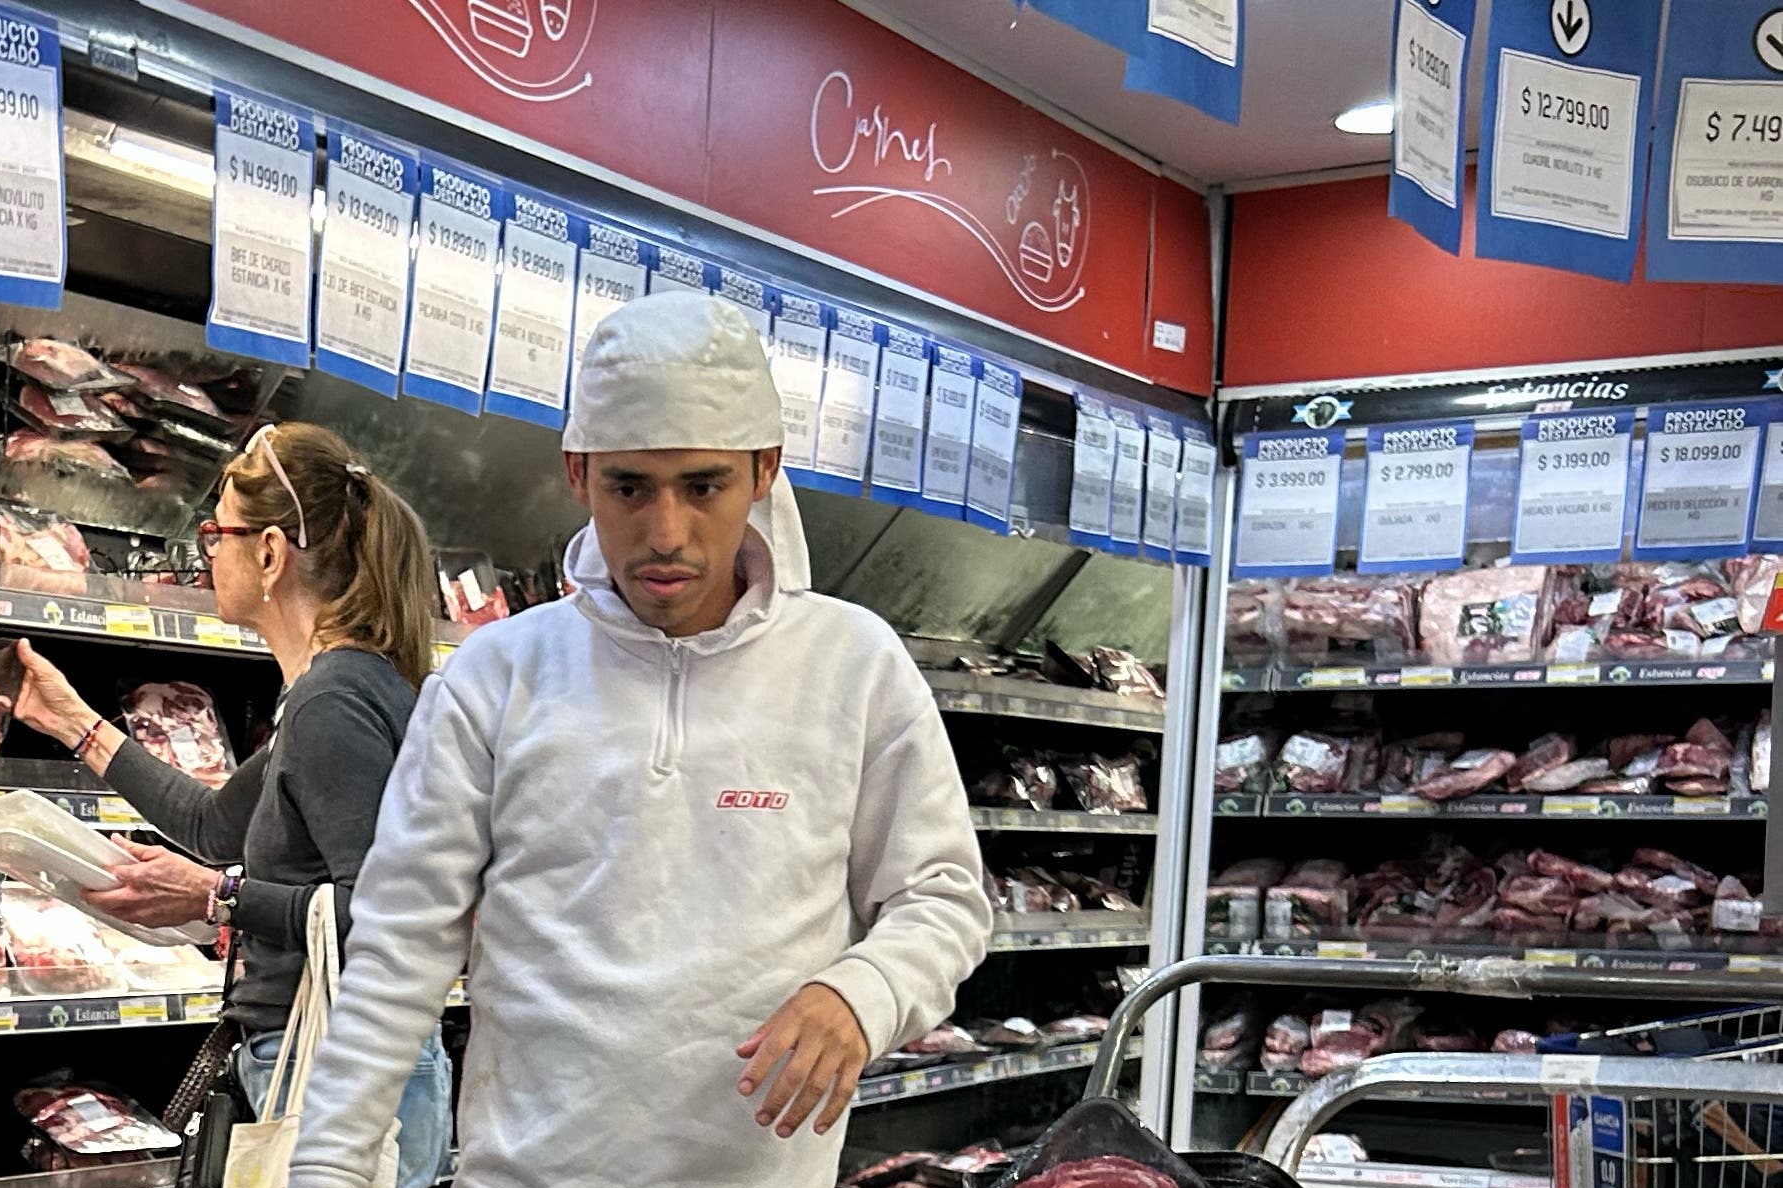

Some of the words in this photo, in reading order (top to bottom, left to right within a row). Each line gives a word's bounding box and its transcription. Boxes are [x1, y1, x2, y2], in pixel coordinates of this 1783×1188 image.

[230, 94, 299, 134] PRODUCTO
[1521, 86, 1531, 116] $
[1537, 91, 1610, 131] 12.799,00
[230, 114, 300, 151] DESTACADO
[811, 70, 952, 182] Carnes
[1706, 111, 1722, 142] $
[230, 155, 238, 183] $
[1538, 415, 1616, 432] PRODUCTO
[1664, 408, 1746, 426] PRODUCTO
[1664, 419, 1745, 434] DESTACADO
[1537, 427, 1616, 443] DESTACADO
[1538, 455, 1547, 471] $
[1661, 447, 1670, 463] $
[69, 608, 107, 627] Estanci
[717, 790, 789, 810] COTO
